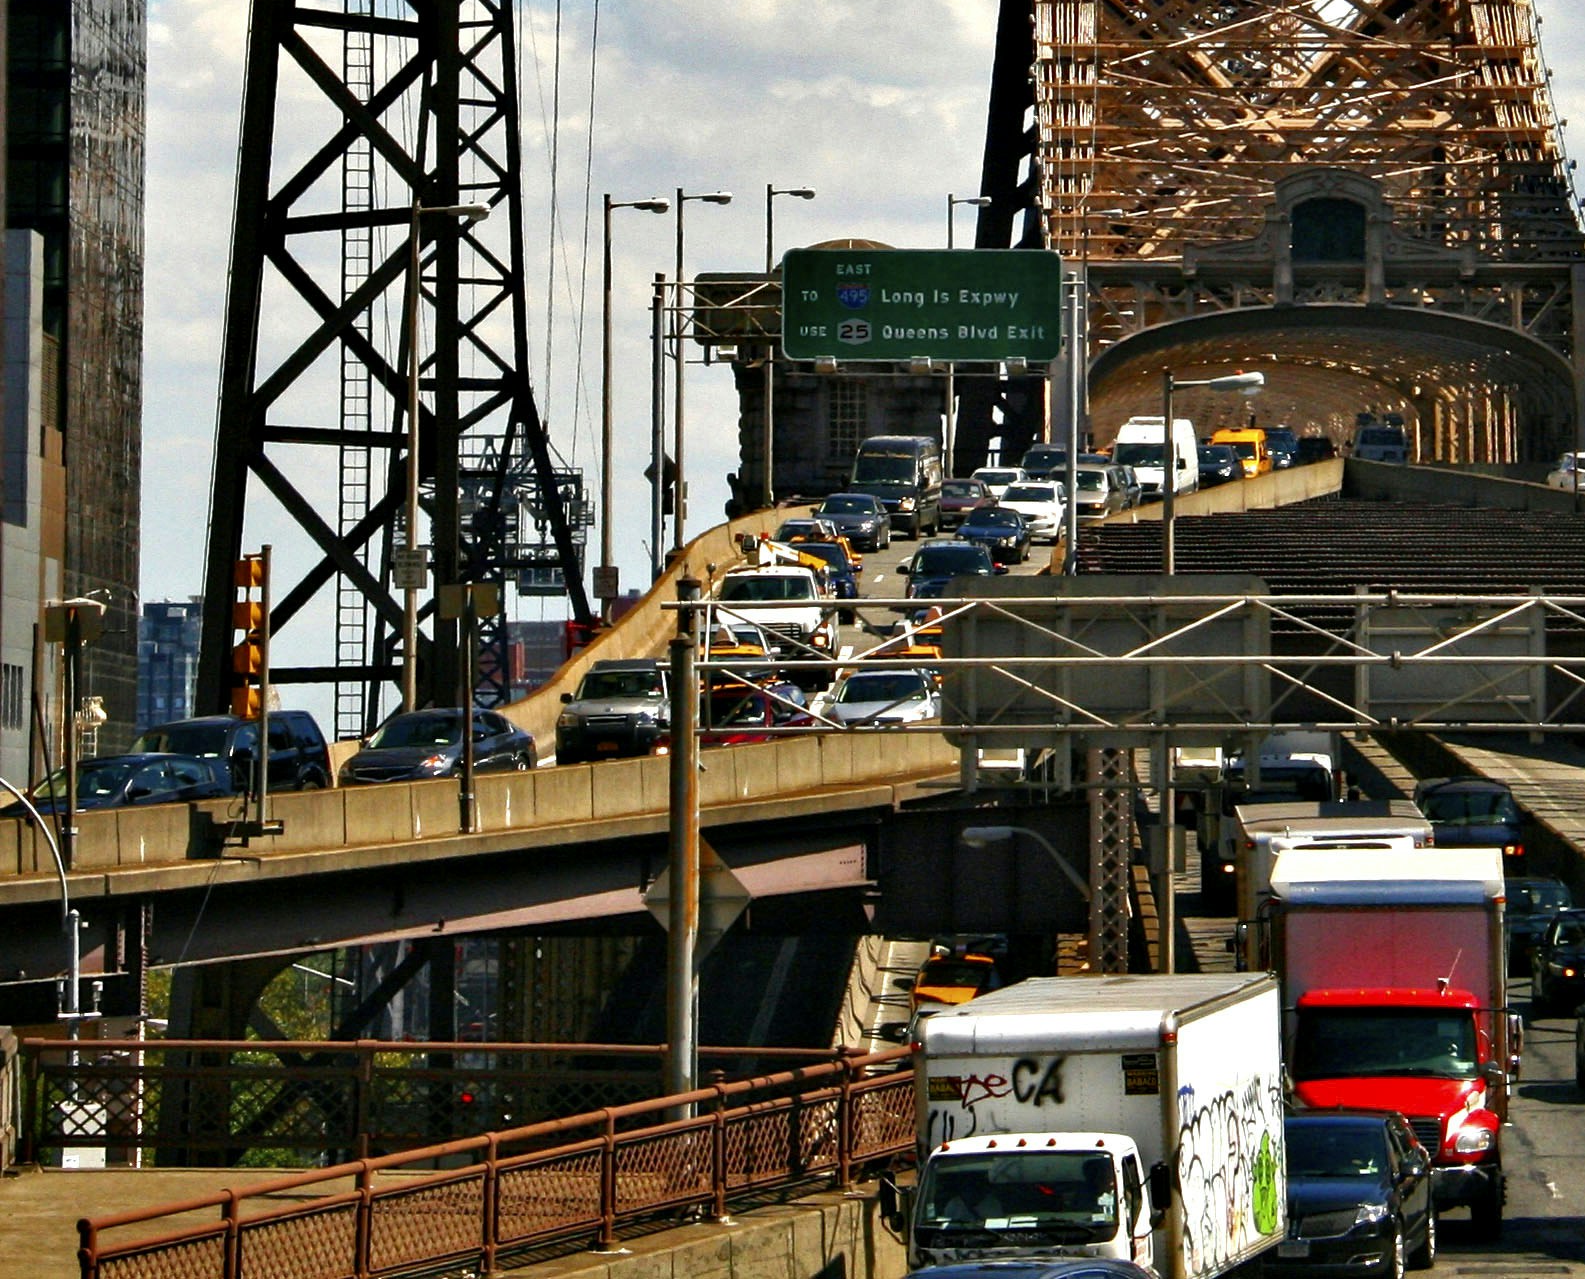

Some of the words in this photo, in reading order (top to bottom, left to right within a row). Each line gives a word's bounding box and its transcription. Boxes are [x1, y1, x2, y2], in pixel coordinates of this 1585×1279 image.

[836, 264, 871, 275] EAST
[801, 290, 818, 301] TO
[839, 289, 867, 303] 495
[881, 289, 924, 307] Long
[933, 289, 949, 303] Is
[959, 289, 1019, 308] Expwy
[800, 326, 827, 337] USE
[839, 325, 868, 339] 25
[882, 325, 949, 339] Queens
[958, 325, 997, 339] Blvd
[1007, 325, 1044, 339] Exit
